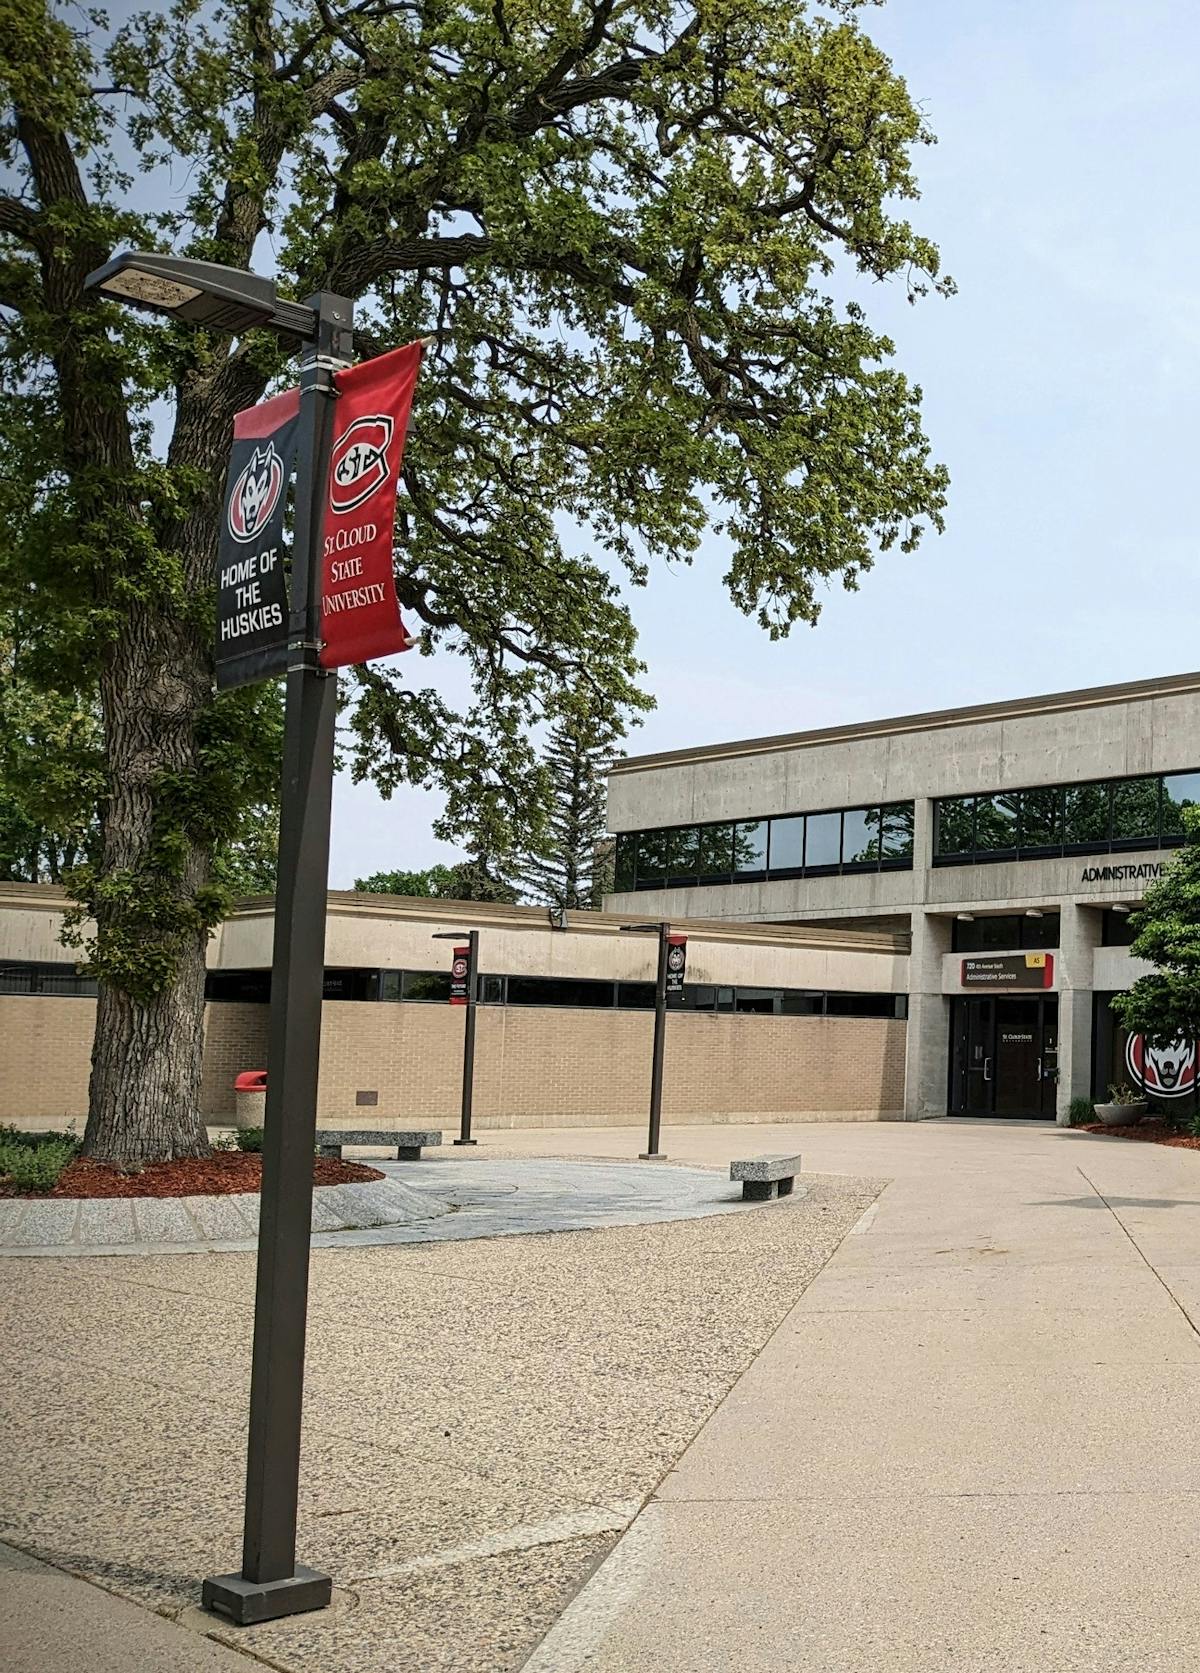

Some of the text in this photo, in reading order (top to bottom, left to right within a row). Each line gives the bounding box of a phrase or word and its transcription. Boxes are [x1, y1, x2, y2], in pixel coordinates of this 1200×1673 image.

[336, 524, 377, 551] CLOUD
[220, 548, 278, 590] HOME OF
[331, 556, 363, 583] STATE
[235, 581, 262, 610] THE
[322, 583, 386, 617] UNIVERSITY
[221, 603, 283, 641] HUSKIES
[1081, 863, 1166, 882] ADMINISTRATIVE
[966, 972, 1017, 981] Administrative Services
